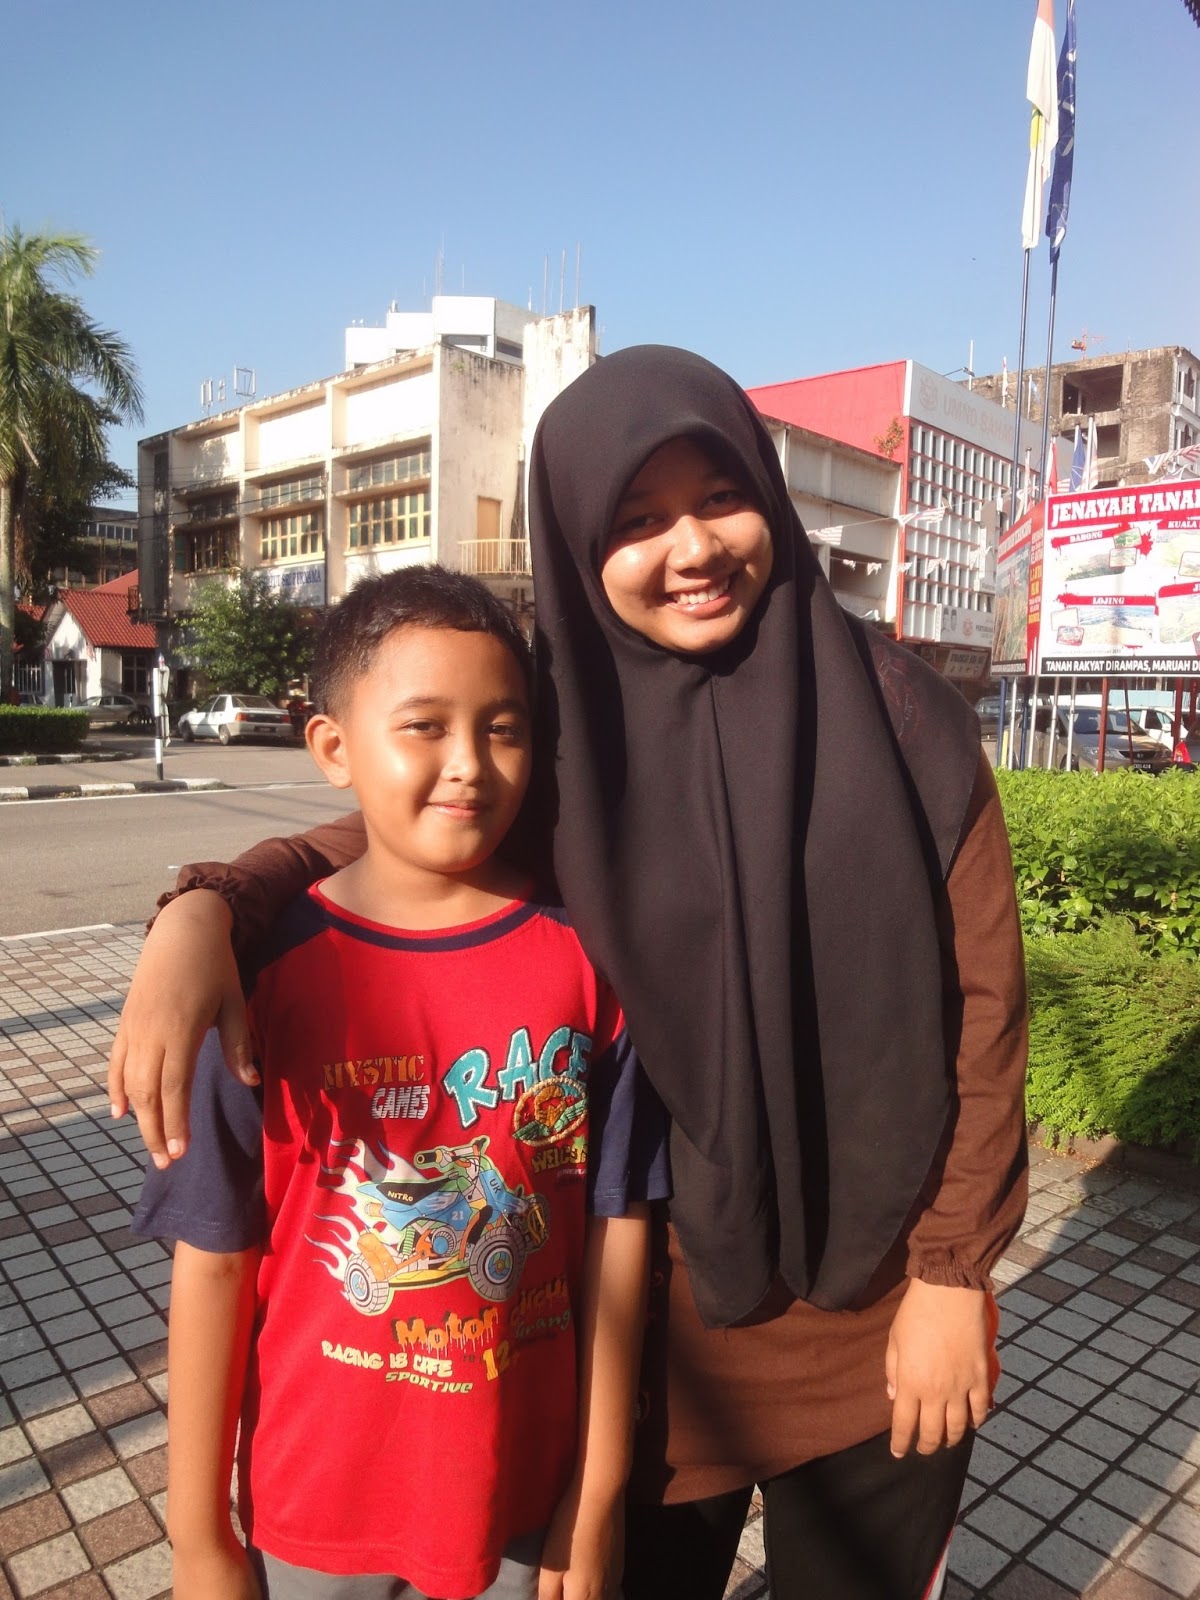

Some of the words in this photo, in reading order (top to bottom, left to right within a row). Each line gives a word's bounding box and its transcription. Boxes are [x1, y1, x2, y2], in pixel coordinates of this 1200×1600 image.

[1051, 495, 1137, 527] JENAYAH
[1167, 520, 1198, 529] KUALA
[1092, 596, 1125, 606] LOJING
[1046, 660, 1072, 672] TANAH
[1073, 660, 1105, 672] RAKYAT
[1105, 659, 1151, 673] DIRAMPAS,
[1152, 660, 1190, 671] MARUAH
[323, 1055, 424, 1090] MYSTIC
[443, 1025, 593, 1130] RACE
[371, 1085, 431, 1119] GAMES
[387, 1190, 414, 1202] NITRO
[489, 1178, 501, 1194] UK
[451, 1210, 464, 1220] 21
[391, 1306, 498, 1354] Motor
[321, 1340, 384, 1370] RACING
[385, 1371, 474, 1394] SPORTIVE
